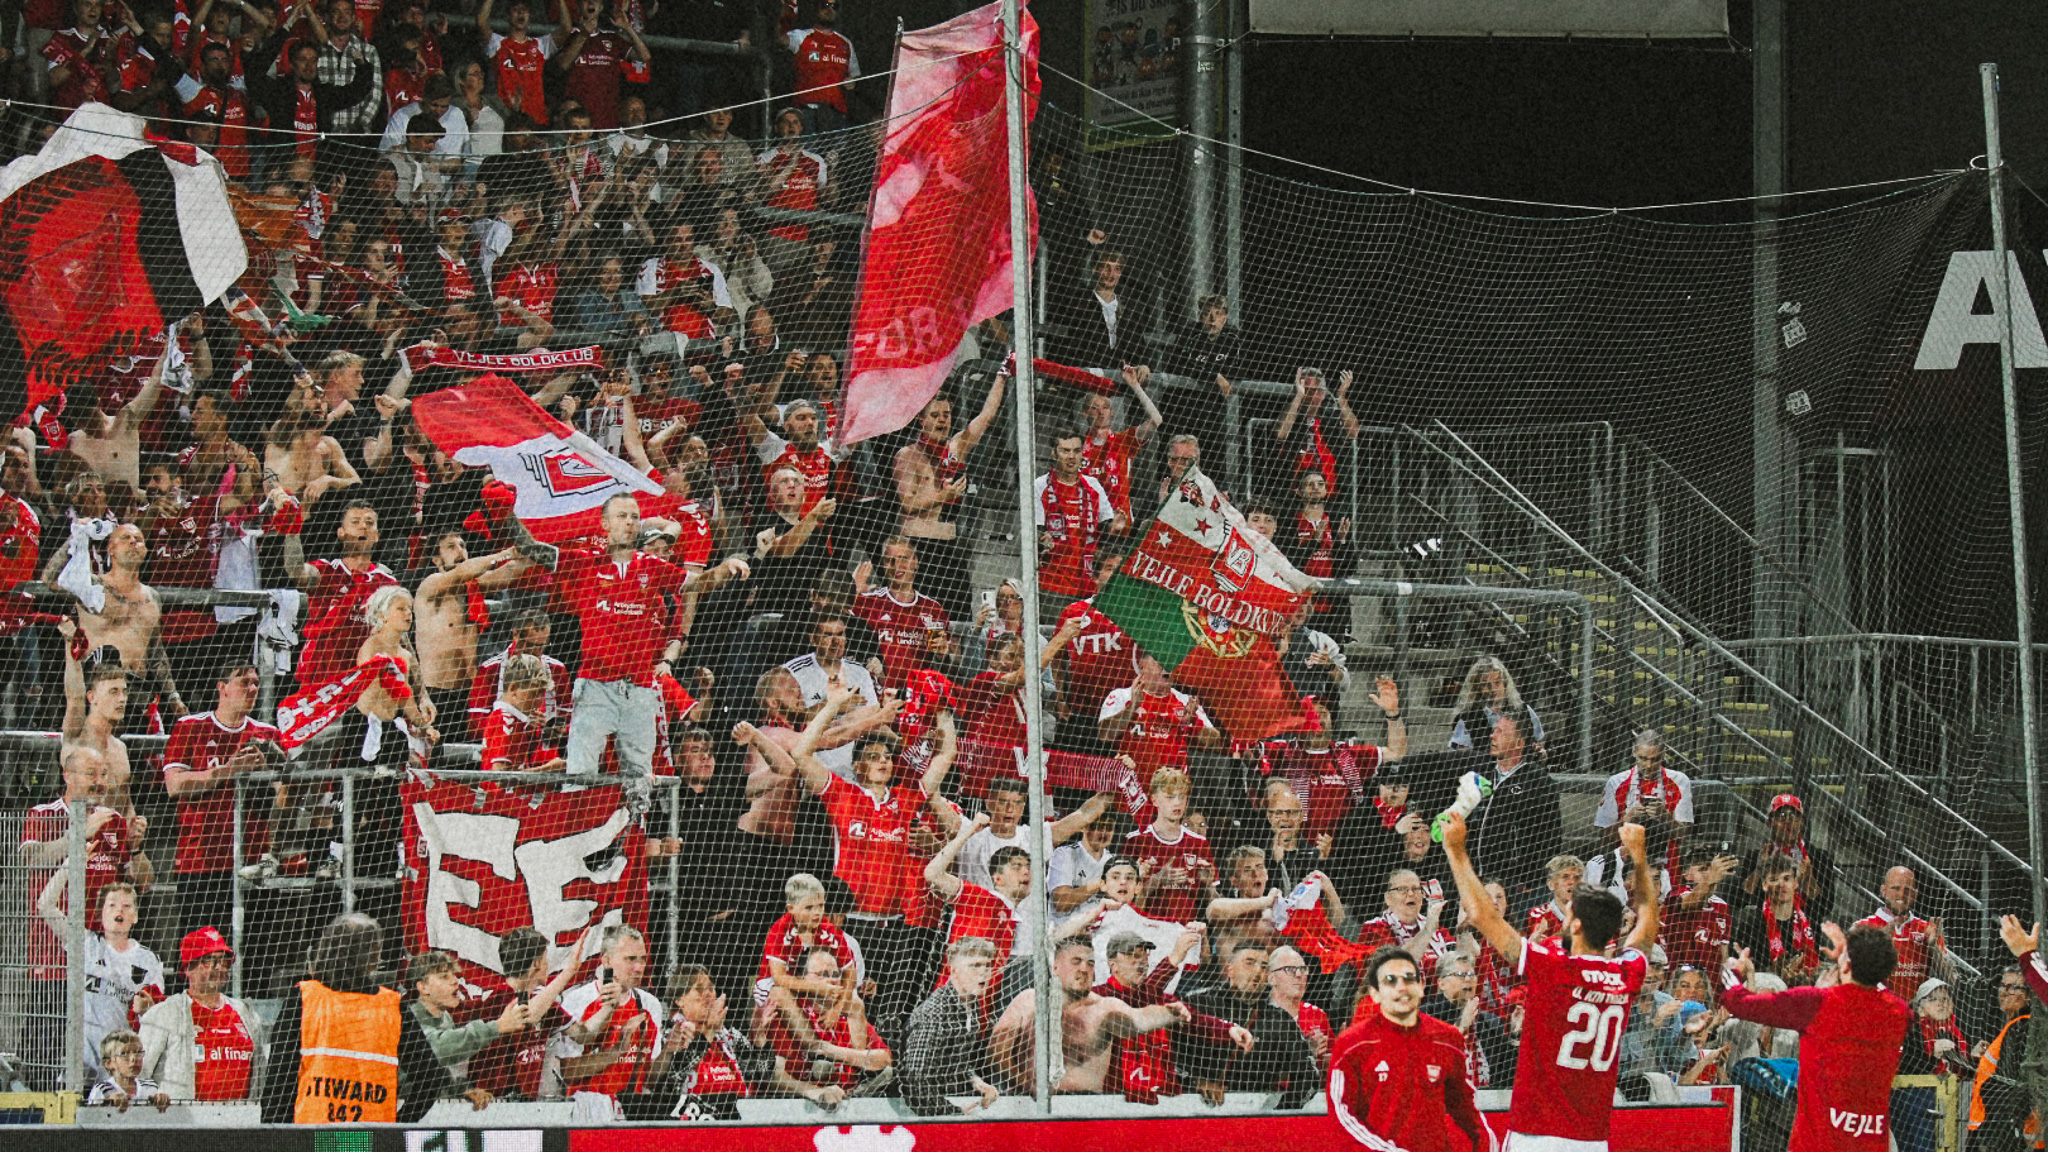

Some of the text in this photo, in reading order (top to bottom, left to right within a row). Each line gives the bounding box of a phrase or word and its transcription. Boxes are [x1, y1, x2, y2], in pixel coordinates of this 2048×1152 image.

[1914, 249, 2048, 370] A
[510, 348, 595, 367] BOLDKLUB
[1131, 551, 1194, 598] VEJLE
[1073, 631, 1122, 655] VTK
[1556, 1001, 1624, 1072] 20
[210, 1046, 222, 1060] al
[1830, 1107, 1885, 1138] VEJLE
